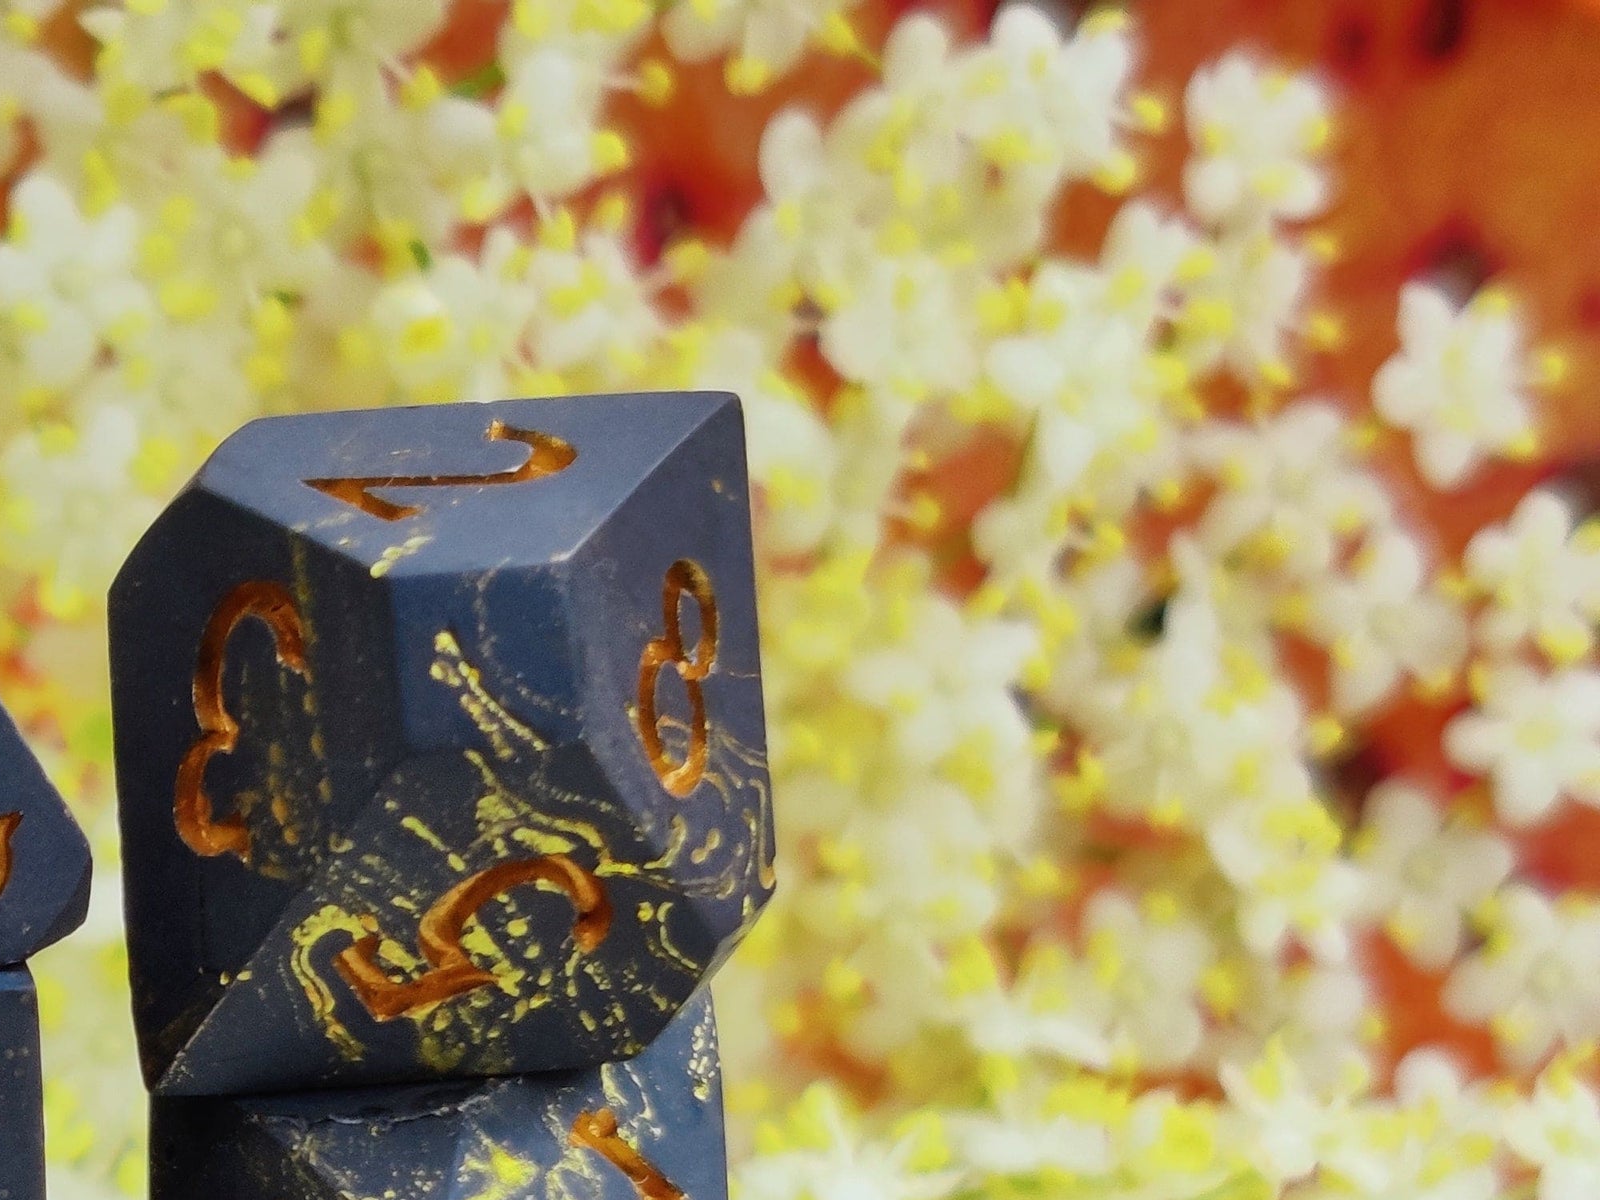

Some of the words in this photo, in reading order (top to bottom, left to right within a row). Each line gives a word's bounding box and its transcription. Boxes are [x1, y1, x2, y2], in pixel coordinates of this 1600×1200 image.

[174, 580, 310, 863] 3
[637, 558, 722, 798] 8
[334, 853, 613, 1022] 5
